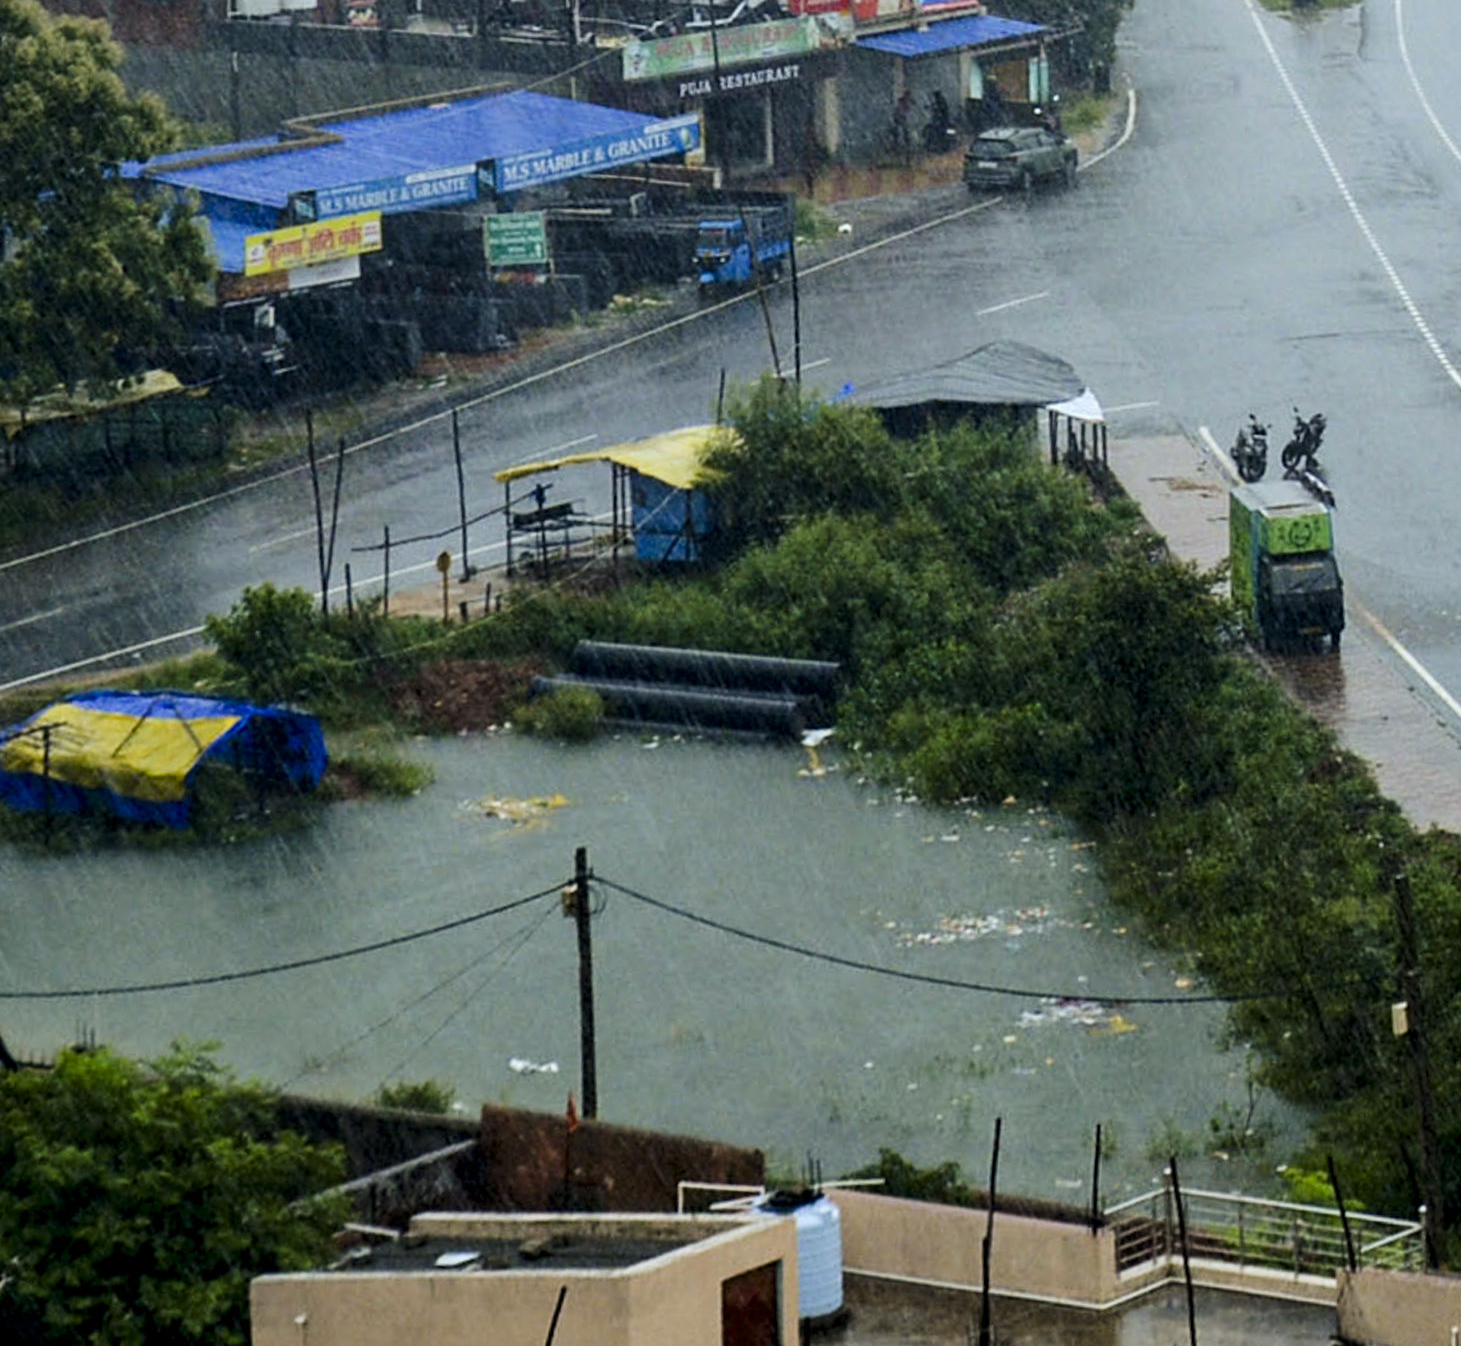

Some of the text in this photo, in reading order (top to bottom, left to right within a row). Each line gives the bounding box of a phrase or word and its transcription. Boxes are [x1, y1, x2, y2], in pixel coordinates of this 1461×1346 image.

[680, 79, 712, 97] PUJA
[503, 163, 529, 179] M.S
[533, 148, 592, 174] MARBLE
[594, 146, 604, 161] &
[608, 132, 672, 158] GRANITE
[346, 188, 396, 209] MARBLE
[412, 177, 469, 199] GRANITE
